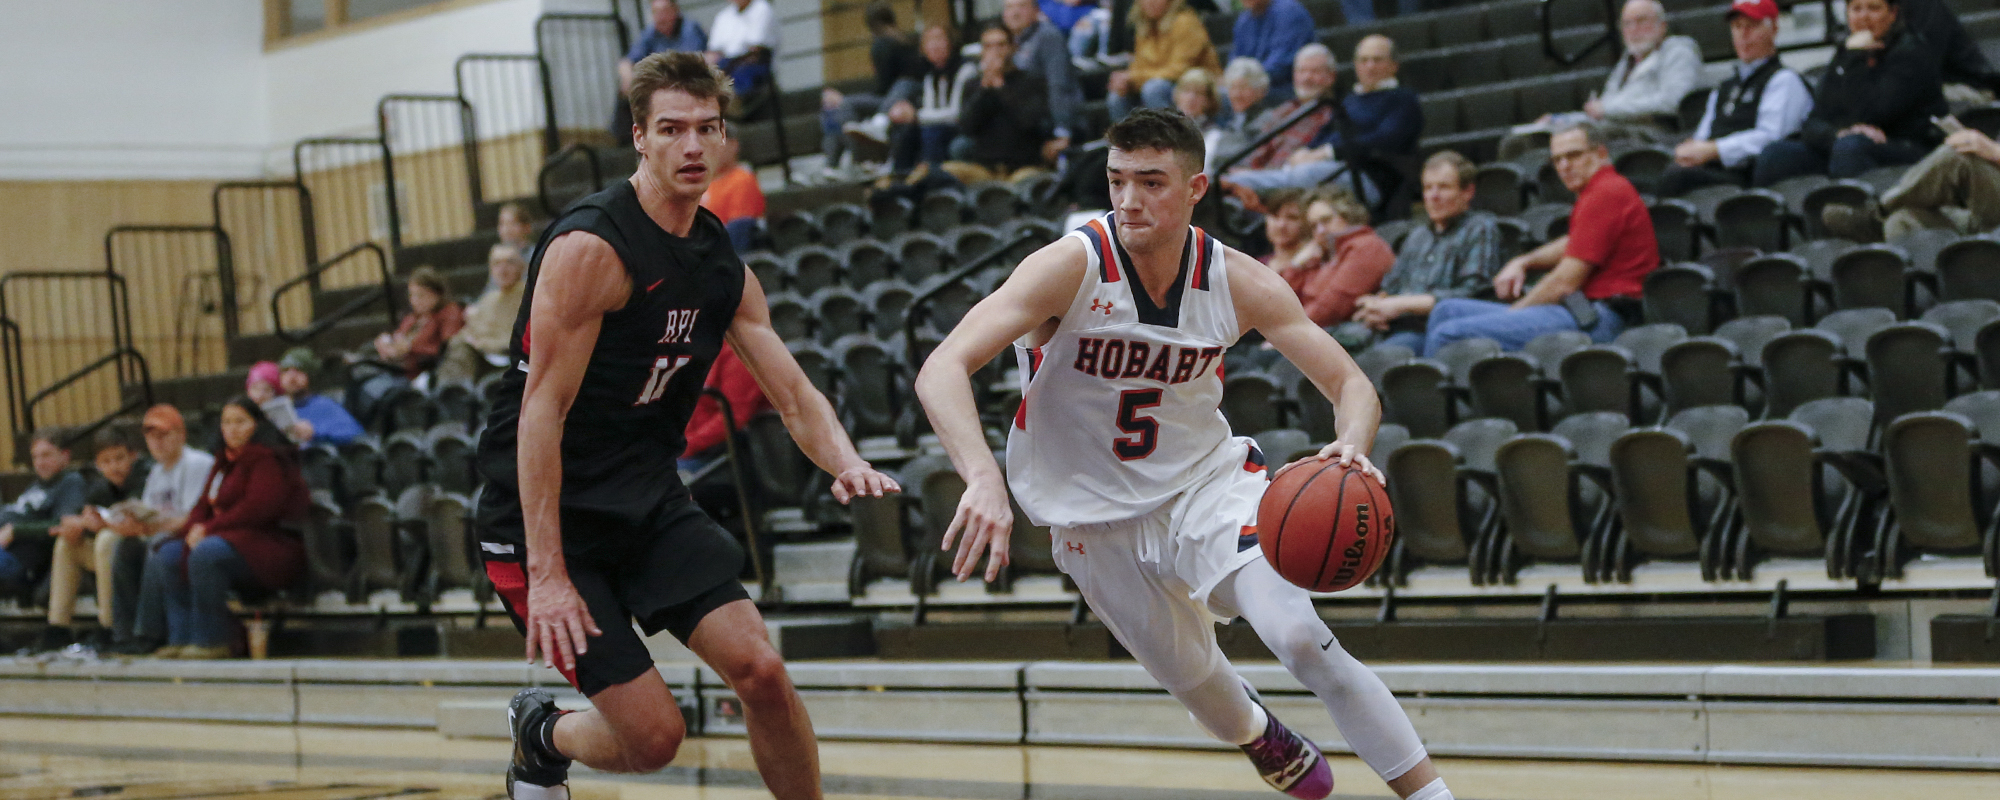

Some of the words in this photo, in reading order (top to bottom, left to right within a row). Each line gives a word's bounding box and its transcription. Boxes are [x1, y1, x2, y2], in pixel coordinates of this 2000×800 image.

[658, 308, 700, 343] RPI
[1073, 337, 1224, 385] HOBART
[1112, 388, 1164, 462] 5
[1329, 503, 1370, 586] Wilson
